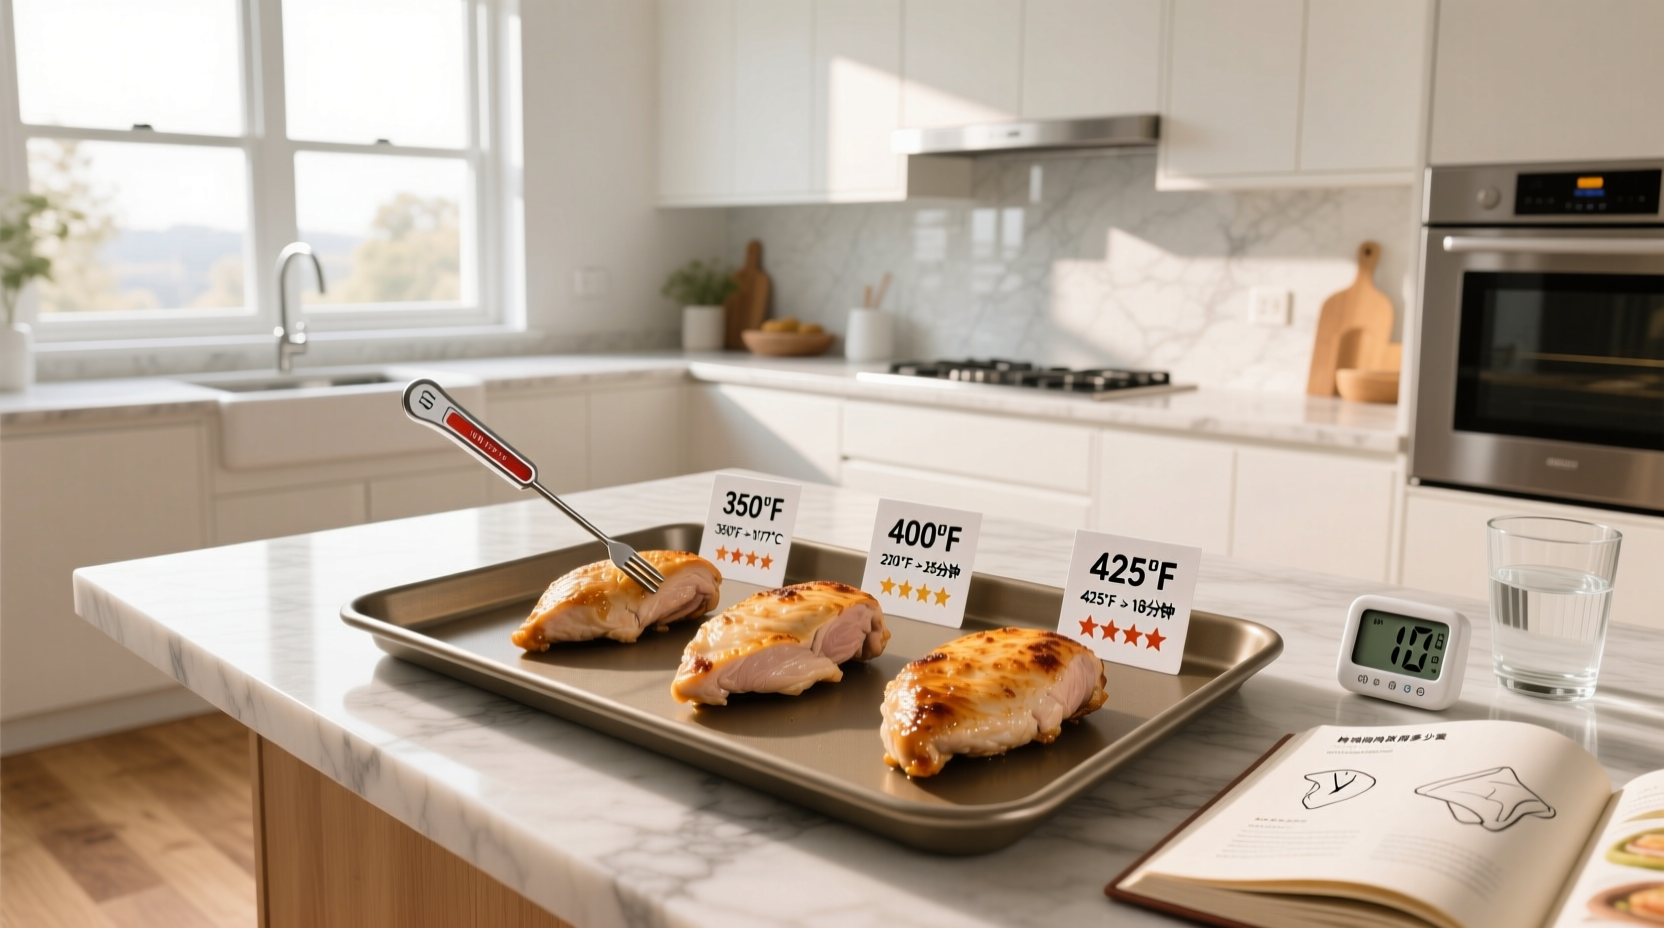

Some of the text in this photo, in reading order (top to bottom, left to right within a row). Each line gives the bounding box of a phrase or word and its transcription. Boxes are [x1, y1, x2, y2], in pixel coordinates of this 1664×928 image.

[723, 491, 784, 521] 350°F
[888, 518, 962, 552] 400°F
[1089, 552, 1177, 591] 425°F
[1080, 590, 1117, 607] 425°F
[1390, 626, 1434, 673] 10
